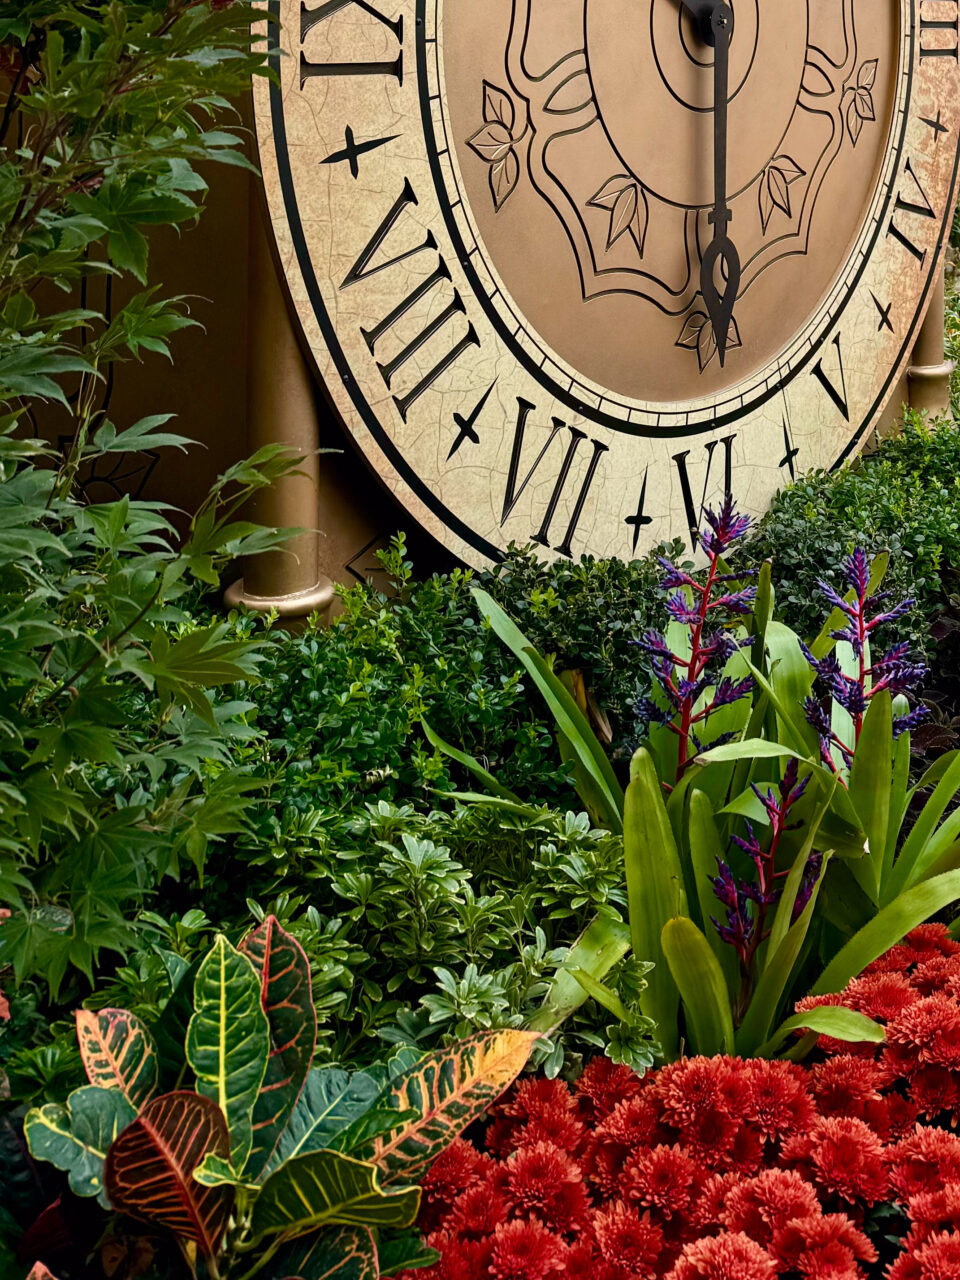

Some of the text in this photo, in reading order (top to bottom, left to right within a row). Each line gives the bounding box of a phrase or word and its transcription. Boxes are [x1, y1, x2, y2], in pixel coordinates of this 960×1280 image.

[886, 157, 936, 272] IV
[339, 177, 481, 424] VIII
[810, 331, 850, 422] V
[500, 396, 609, 558] VII
[671, 433, 737, 553] VI
